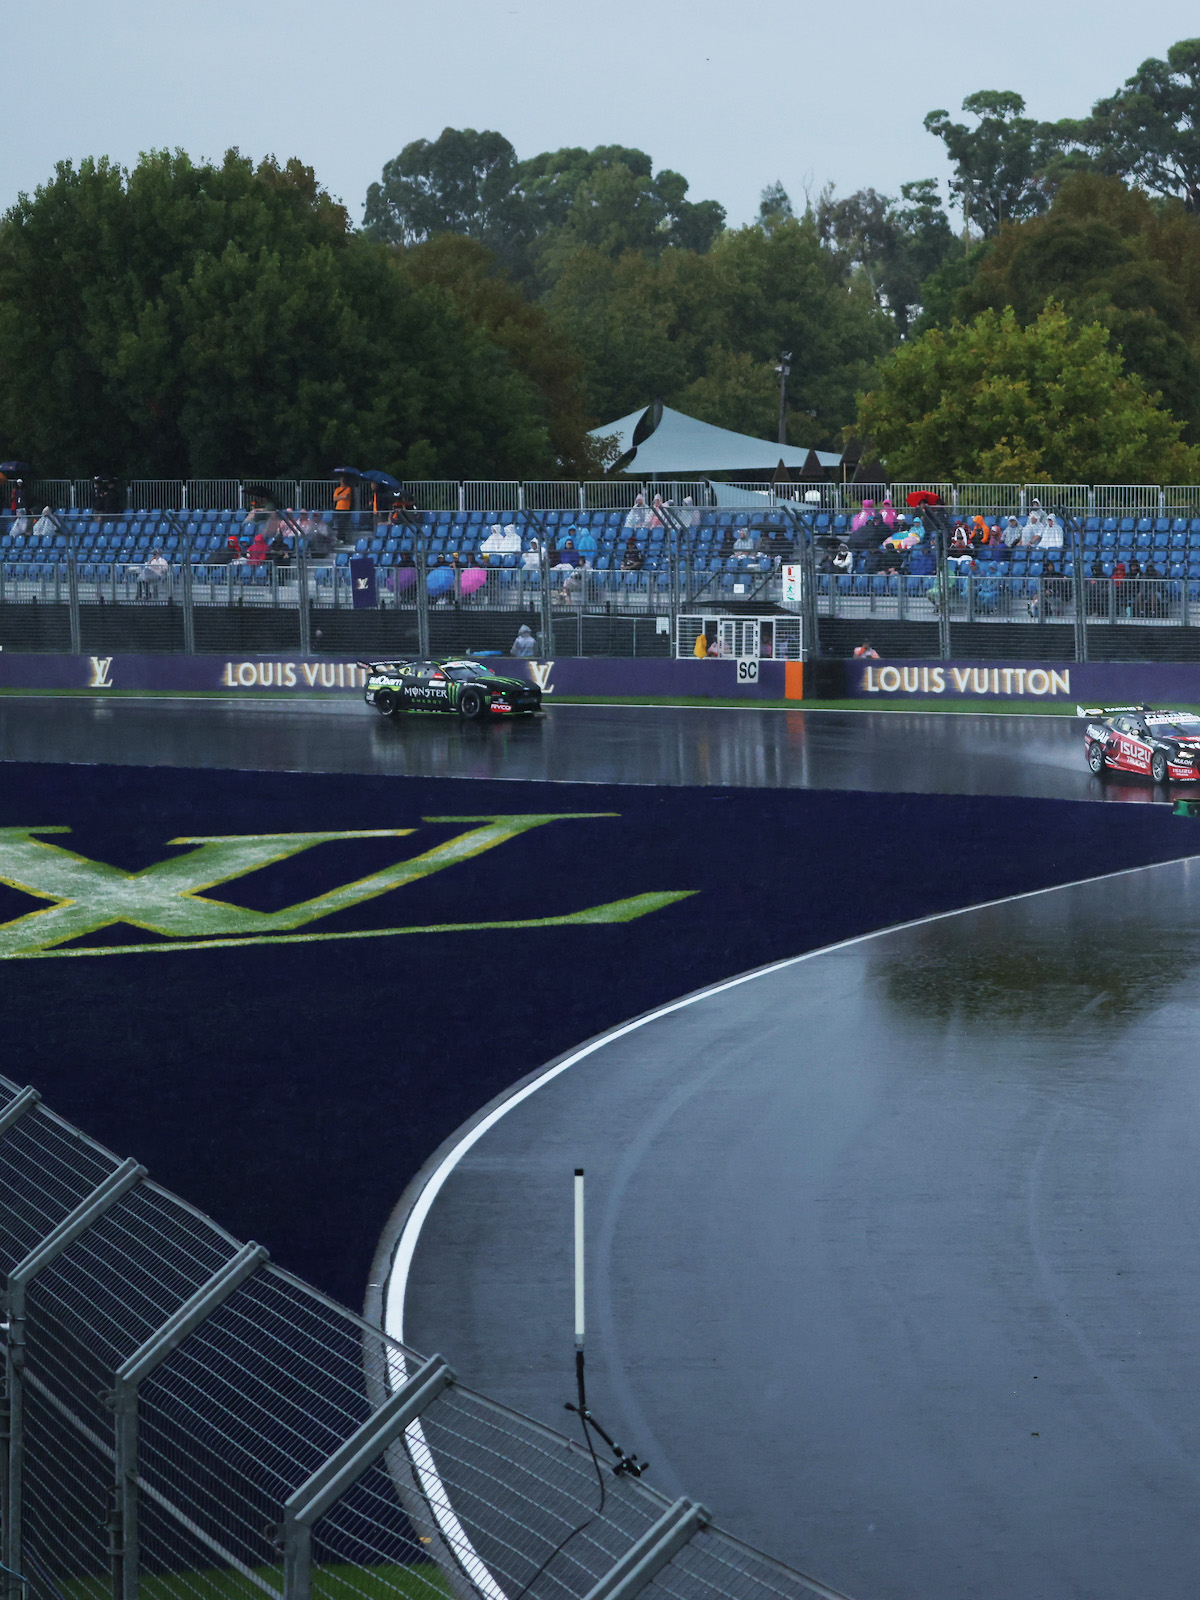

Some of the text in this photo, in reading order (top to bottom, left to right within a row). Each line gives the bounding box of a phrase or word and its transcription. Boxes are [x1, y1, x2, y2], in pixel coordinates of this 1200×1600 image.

[226, 662, 296, 687] LOUIS
[739, 662, 757, 679] SC
[867, 666, 1070, 695] LOUIS VUITTON
[403, 686, 448, 699] MONSTER
[490, 703, 511, 711] RYCO
[1120, 740, 1151, 764] ISUZU
[1126, 756, 1147, 769] TRUCKS
[1173, 757, 1194, 766] NULON
